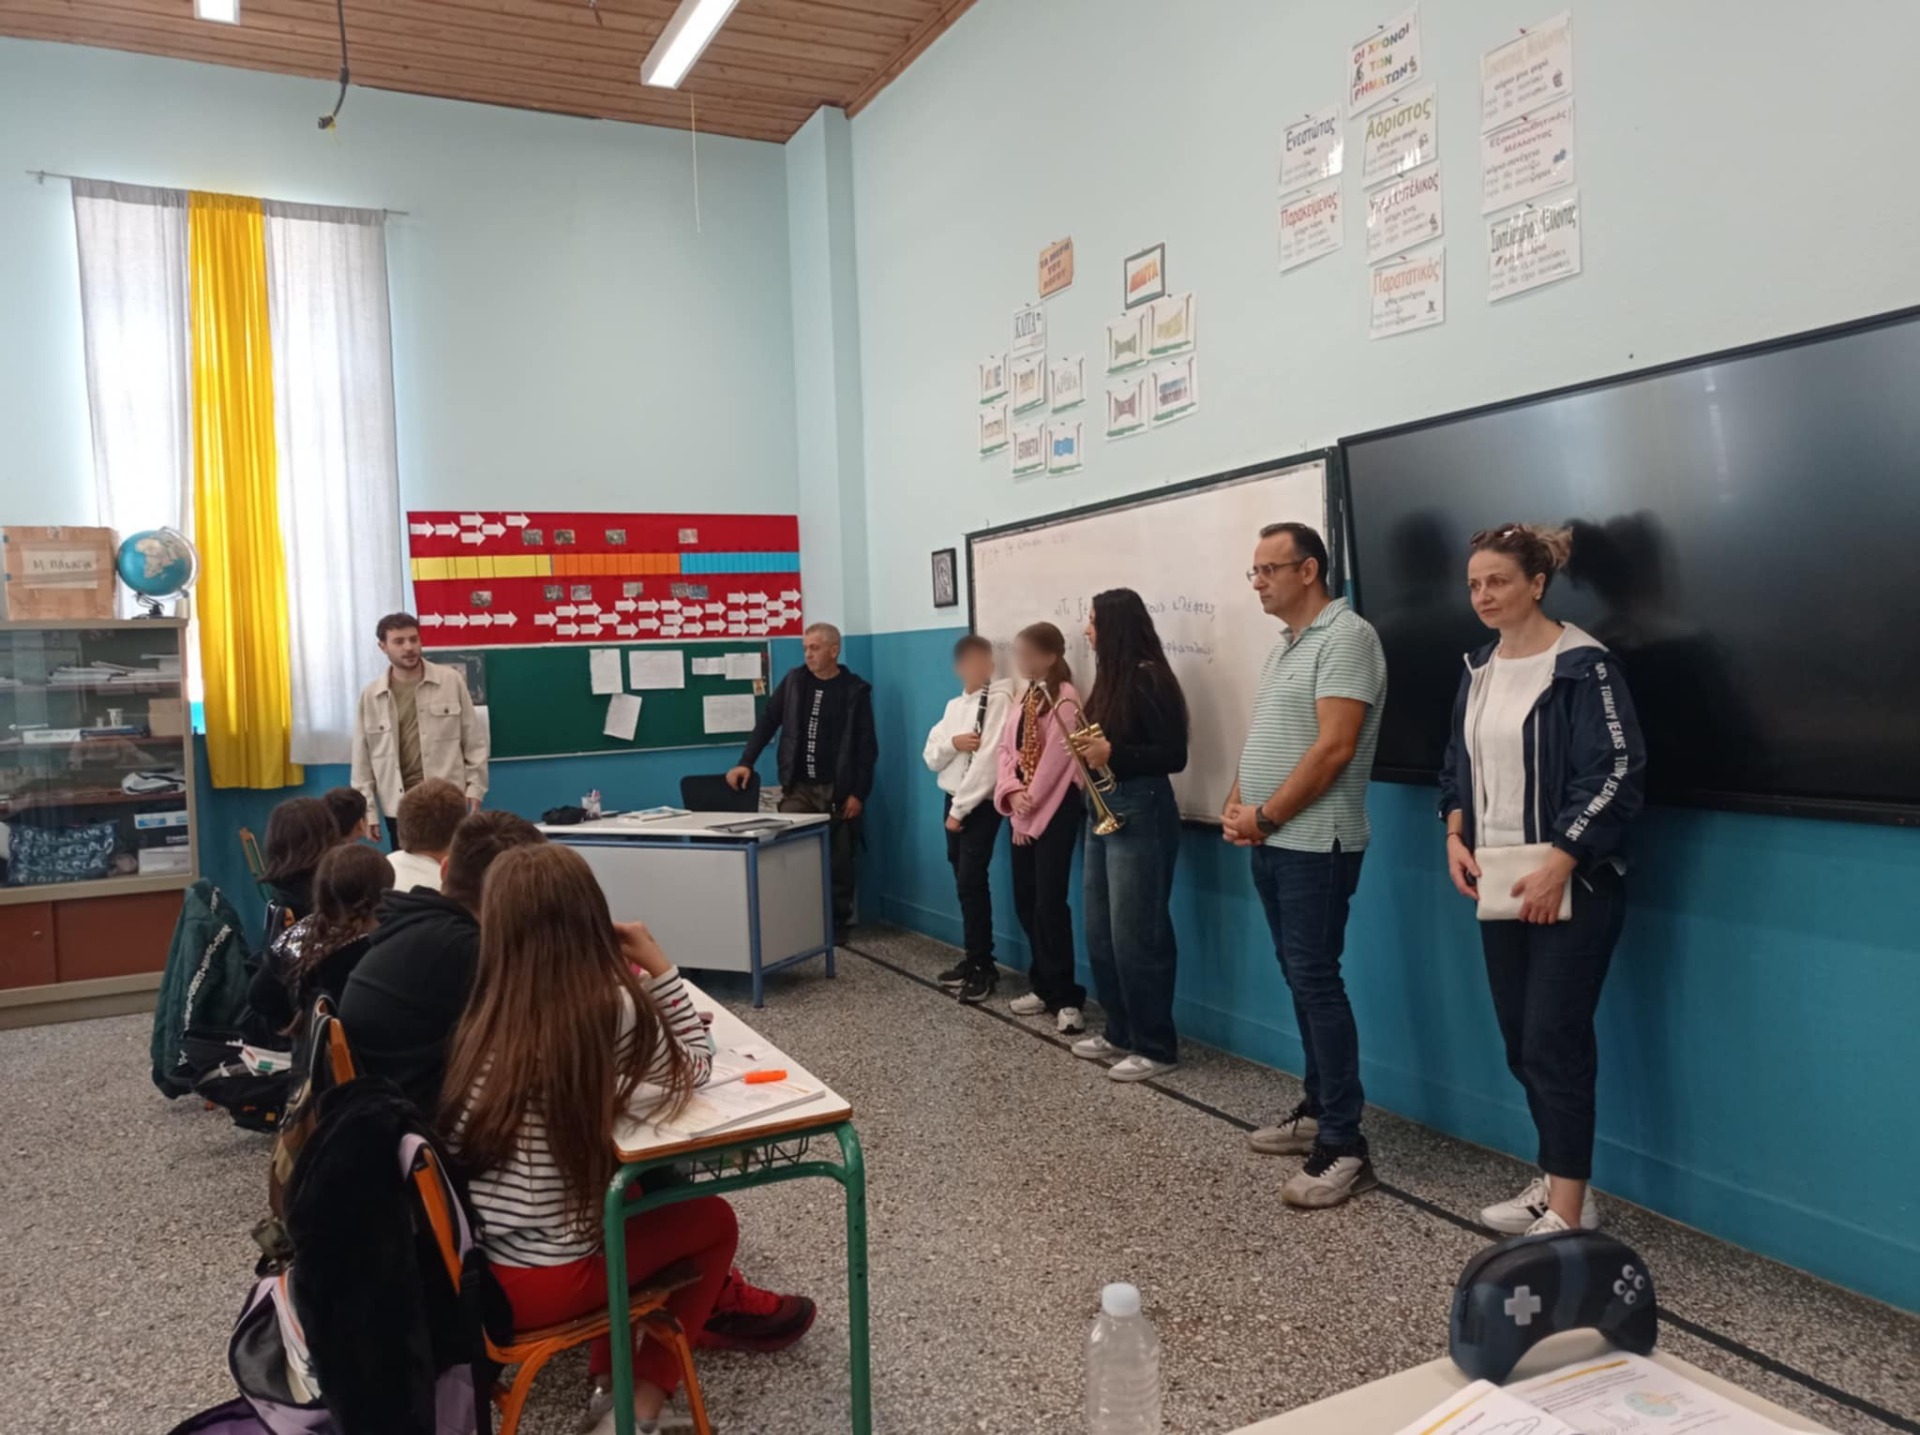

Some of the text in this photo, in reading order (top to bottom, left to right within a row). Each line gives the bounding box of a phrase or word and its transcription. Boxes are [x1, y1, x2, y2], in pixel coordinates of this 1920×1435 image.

[1286, 117, 1336, 152] Ενεστώτας
[1365, 97, 1431, 143] Αόριστος
[1600, 685, 1618, 720] TOMMY
[1607, 719, 1627, 750] JEANS
